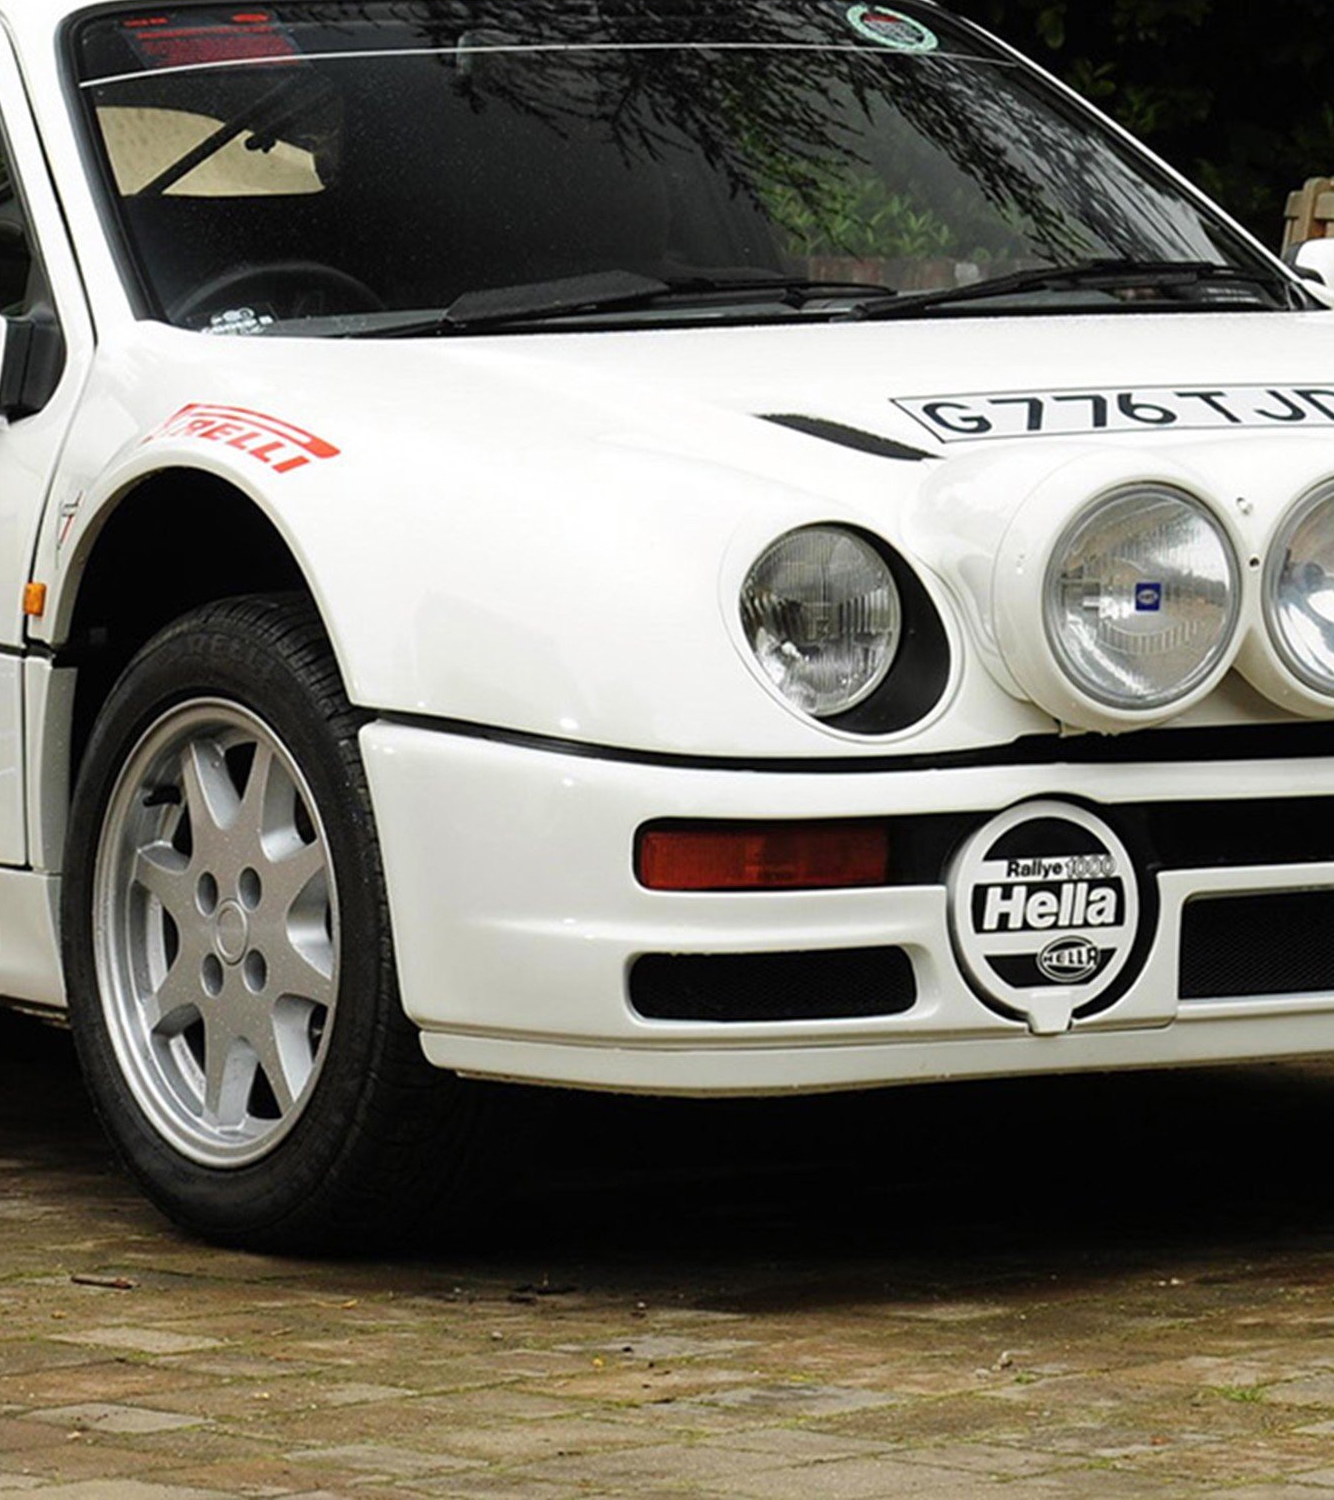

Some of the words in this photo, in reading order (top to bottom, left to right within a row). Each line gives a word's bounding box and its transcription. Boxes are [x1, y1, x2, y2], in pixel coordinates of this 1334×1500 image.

[922, 392, 1177, 434] G776
[1007, 858, 1063, 879] Rallye
[983, 882, 1117, 931] Hella
